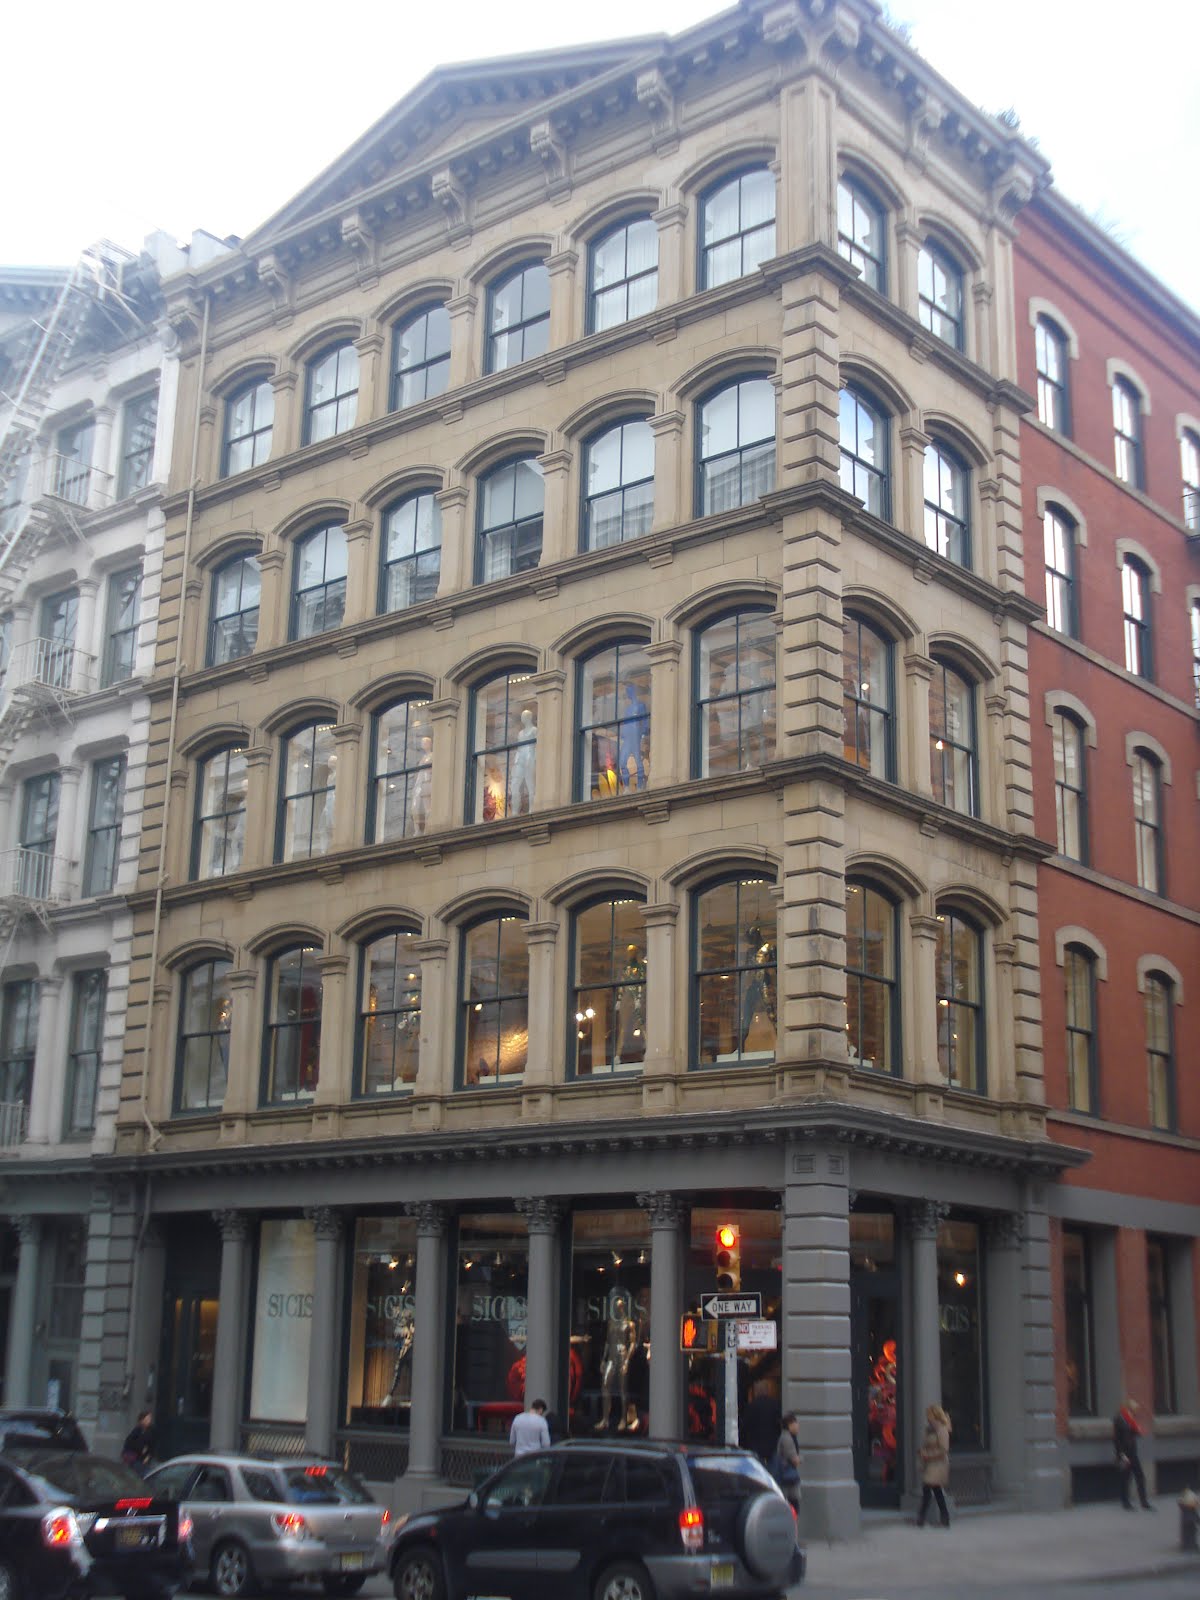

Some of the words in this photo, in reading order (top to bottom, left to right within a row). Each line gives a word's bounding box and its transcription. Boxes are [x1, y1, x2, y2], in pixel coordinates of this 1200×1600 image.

[268, 1294, 313, 1318] SICIS
[712, 1303, 729, 1312] ONE
[734, 1302, 752, 1311] WAY
